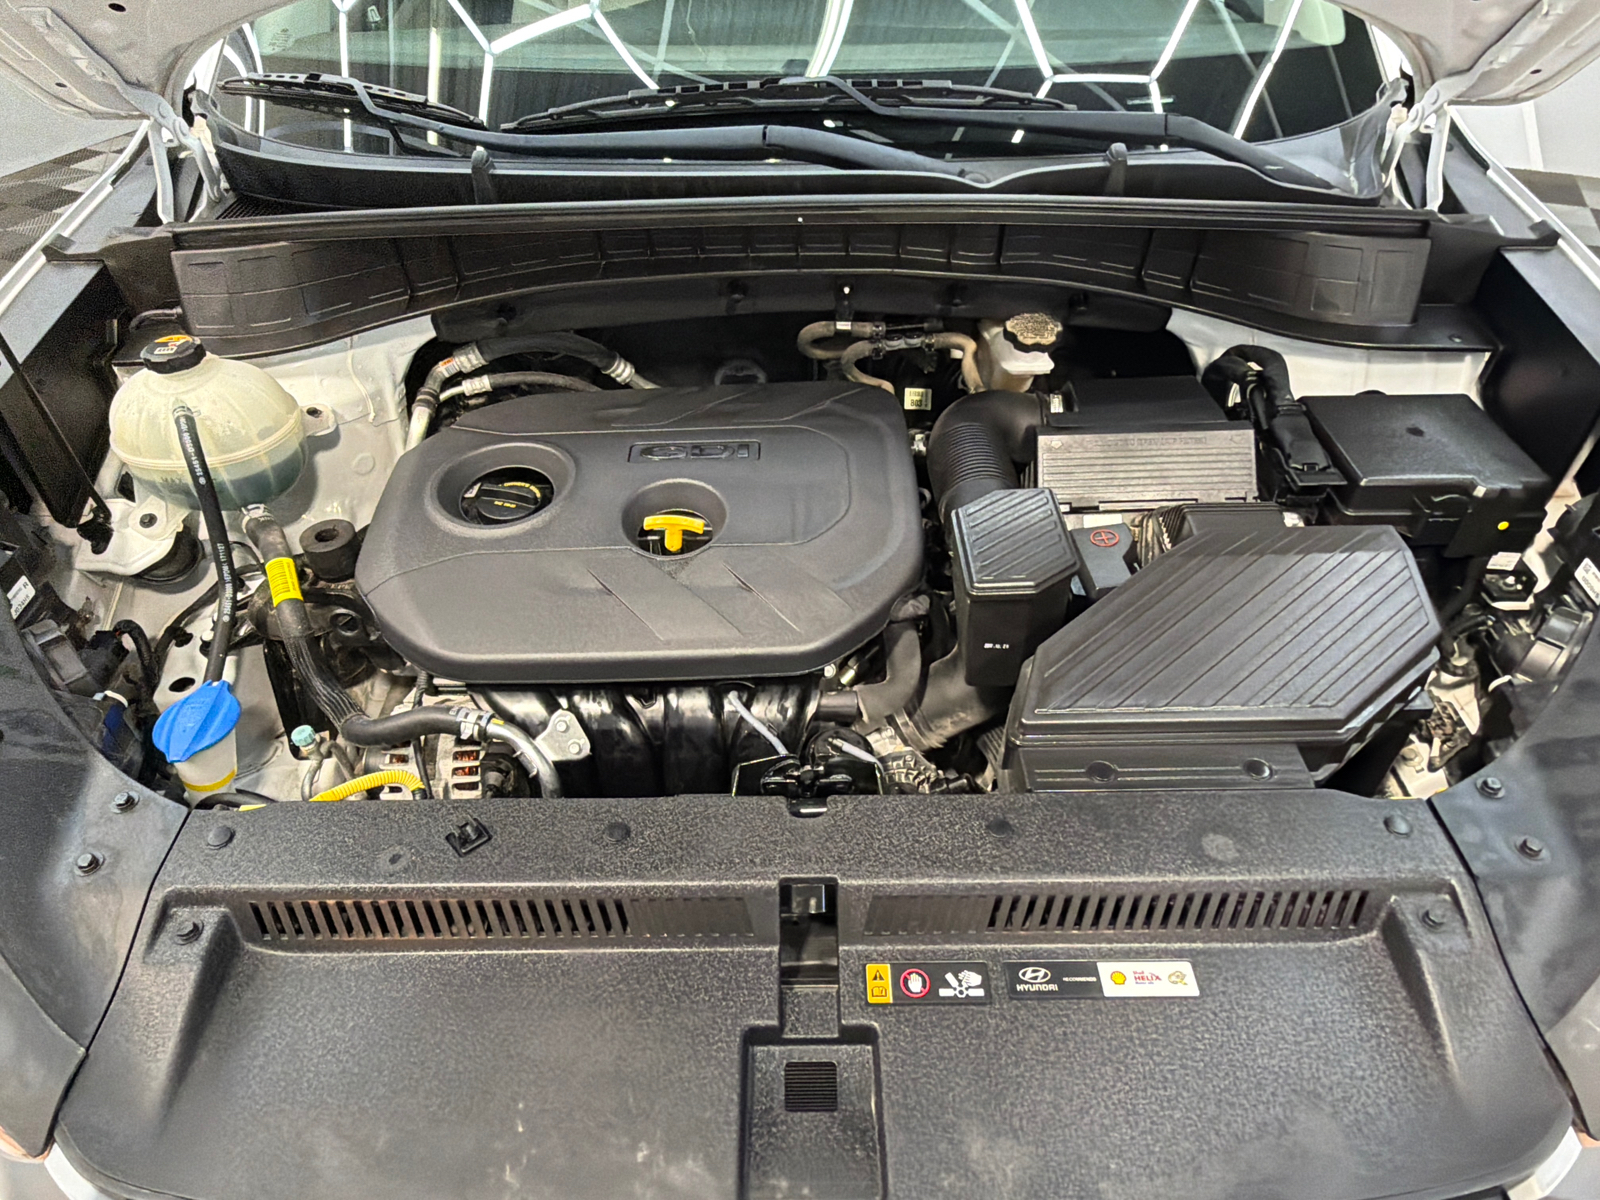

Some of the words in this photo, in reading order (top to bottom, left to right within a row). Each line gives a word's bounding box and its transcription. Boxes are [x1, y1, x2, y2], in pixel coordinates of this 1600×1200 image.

[640, 444, 749, 460] GDI
[1134, 972, 1162, 982] HELIX
[1016, 983, 1059, 992] HYUNDAI
